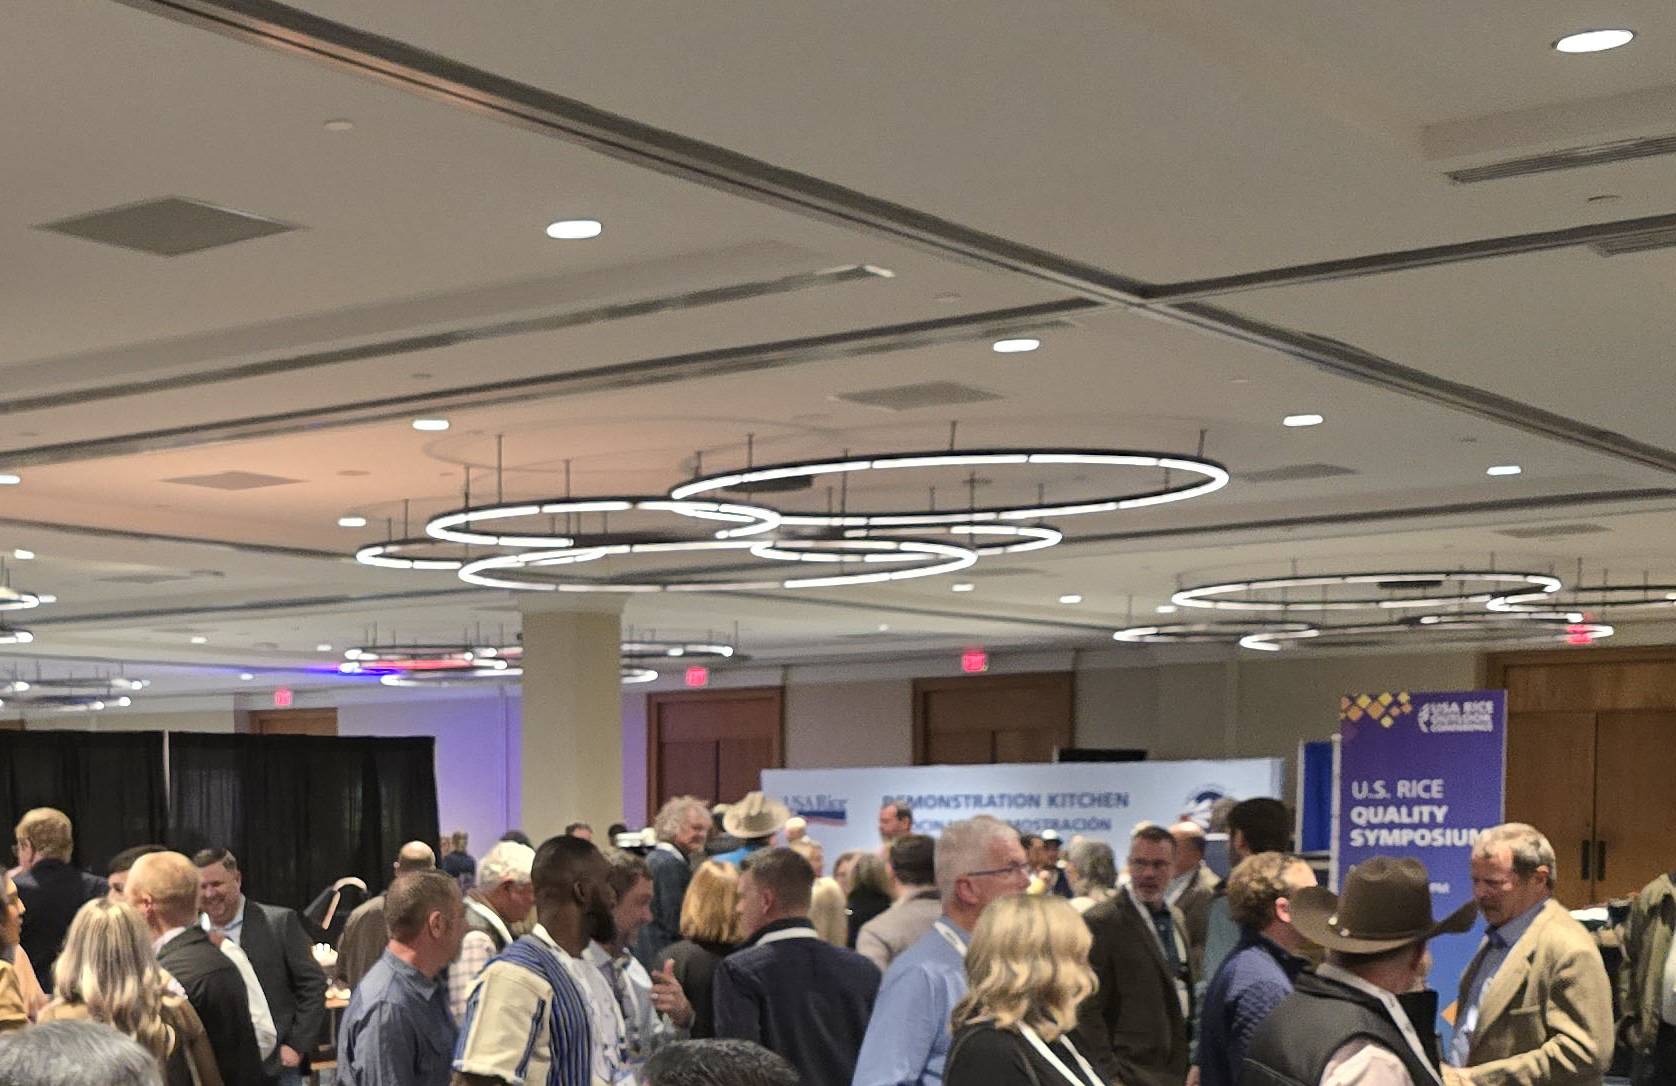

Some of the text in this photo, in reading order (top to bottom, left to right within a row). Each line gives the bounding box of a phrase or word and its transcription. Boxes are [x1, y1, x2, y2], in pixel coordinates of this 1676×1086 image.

[1048, 792, 1130, 808] KITCHEN
[1351, 779, 1445, 800] U.S. RICE
[1350, 805, 1448, 826] QUALITY
